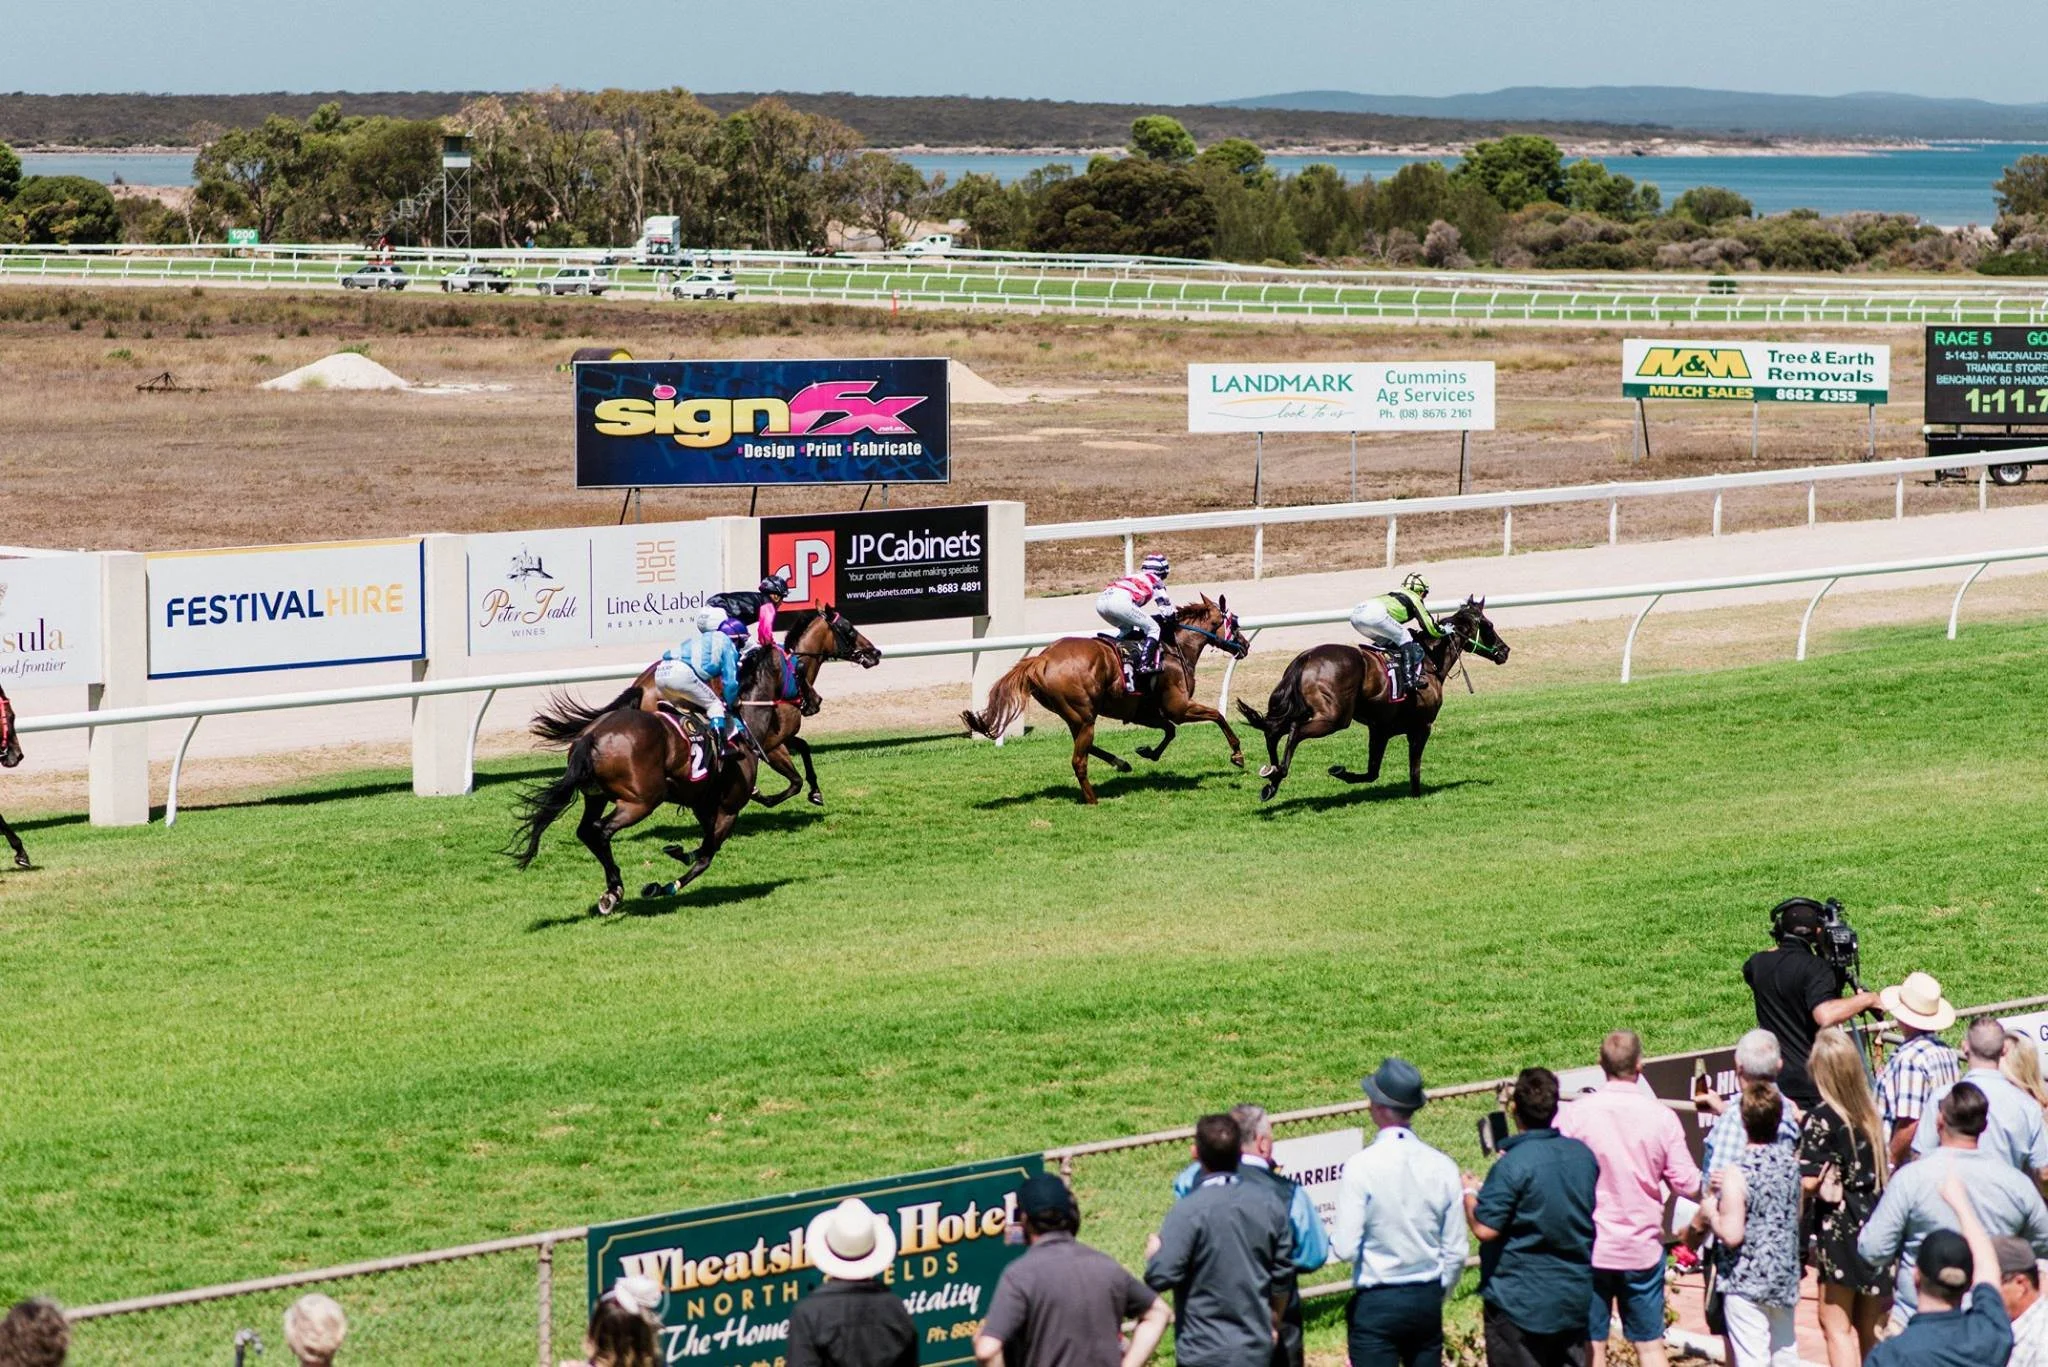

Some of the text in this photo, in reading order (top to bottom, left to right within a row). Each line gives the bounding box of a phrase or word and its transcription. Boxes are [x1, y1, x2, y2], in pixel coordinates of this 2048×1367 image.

[231, 230, 256, 240] 1200
[1935, 331, 1978, 346] RACE
[1983, 331, 1993, 346] 5
[1636, 347, 1752, 379] M&M
[1768, 350, 1874, 365] Tree & Earth
[1385, 369, 1467, 385] Cummins
[1768, 367, 1874, 383] Removals
[1965, 363, 2013, 373] TRIANGLE
[1211, 374, 1354, 393] LANDMARK
[1936, 375, 1997, 385] BENCHMARK
[1376, 387, 1475, 406] Ag Services
[1649, 386, 1754, 399] MULCH SALES
[1776, 388, 1857, 402] 8682 4355
[1274, 402, 1306, 419] look
[1311, 403, 1328, 419] to
[1379, 408, 1472, 420] Ph. (08) 8676 2161
[744, 441, 922, 459] Design Print Fabricate
[848, 563, 979, 582] Your complete cabinet making specialists
[846, 586, 924, 600] www.jpcabinets.com.au
[960, 581, 981, 591] 4891
[480, 586, 578, 628] Peter Teakle
[607, 590, 704, 615] Line & Label
[607, 616, 695, 628] RESTAURAN
[0, 617, 66, 653] sula
[511, 628, 546, 637] WINES
[0, 657, 67, 678] ood frontier
[1388, 668, 1397, 699] 1
[690, 743, 708, 779] 2
[619, 1191, 1018, 1292] Wheatsh Hotel
[687, 1252, 959, 1320] NORTH ELDS
[658, 1323, 711, 1363] The
[713, 1314, 790, 1350] Home
